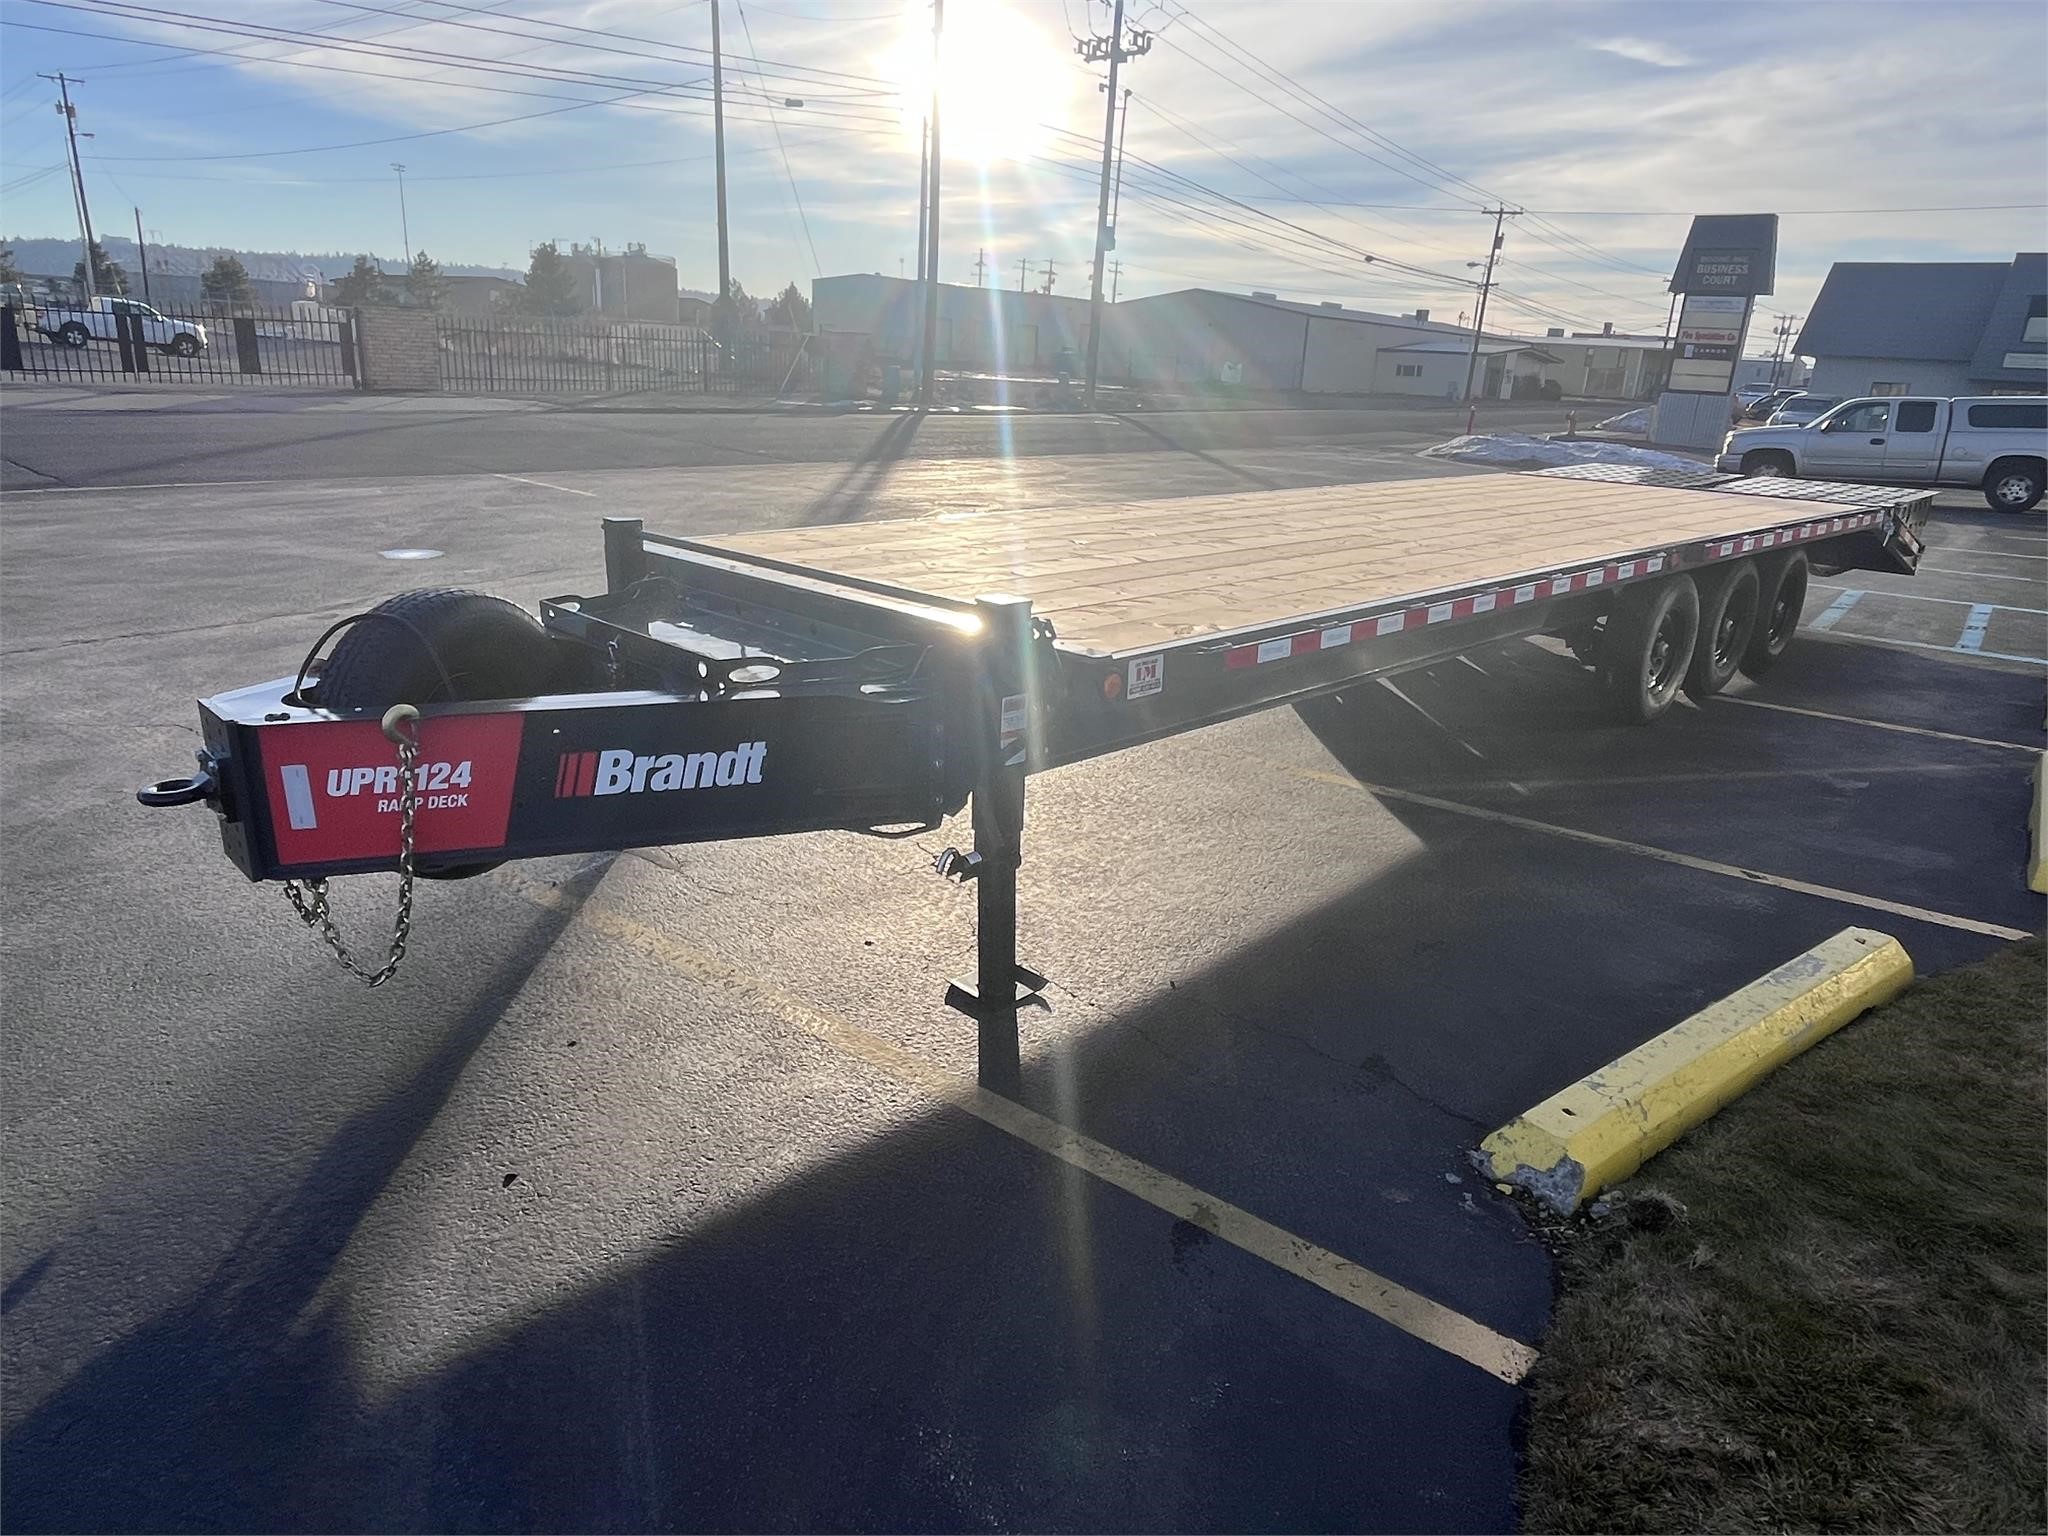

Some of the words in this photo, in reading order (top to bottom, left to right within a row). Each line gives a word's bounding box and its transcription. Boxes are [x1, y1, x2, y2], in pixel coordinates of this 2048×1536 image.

[1696, 264, 1749, 274] BUSINESS
[1702, 275, 1738, 285] COURT
[594, 741, 767, 796] Brandt
[327, 766, 397, 797] UPR
[415, 761, 472, 791] 124
[378, 797, 424, 813] RAP
[428, 794, 469, 809] DECK
